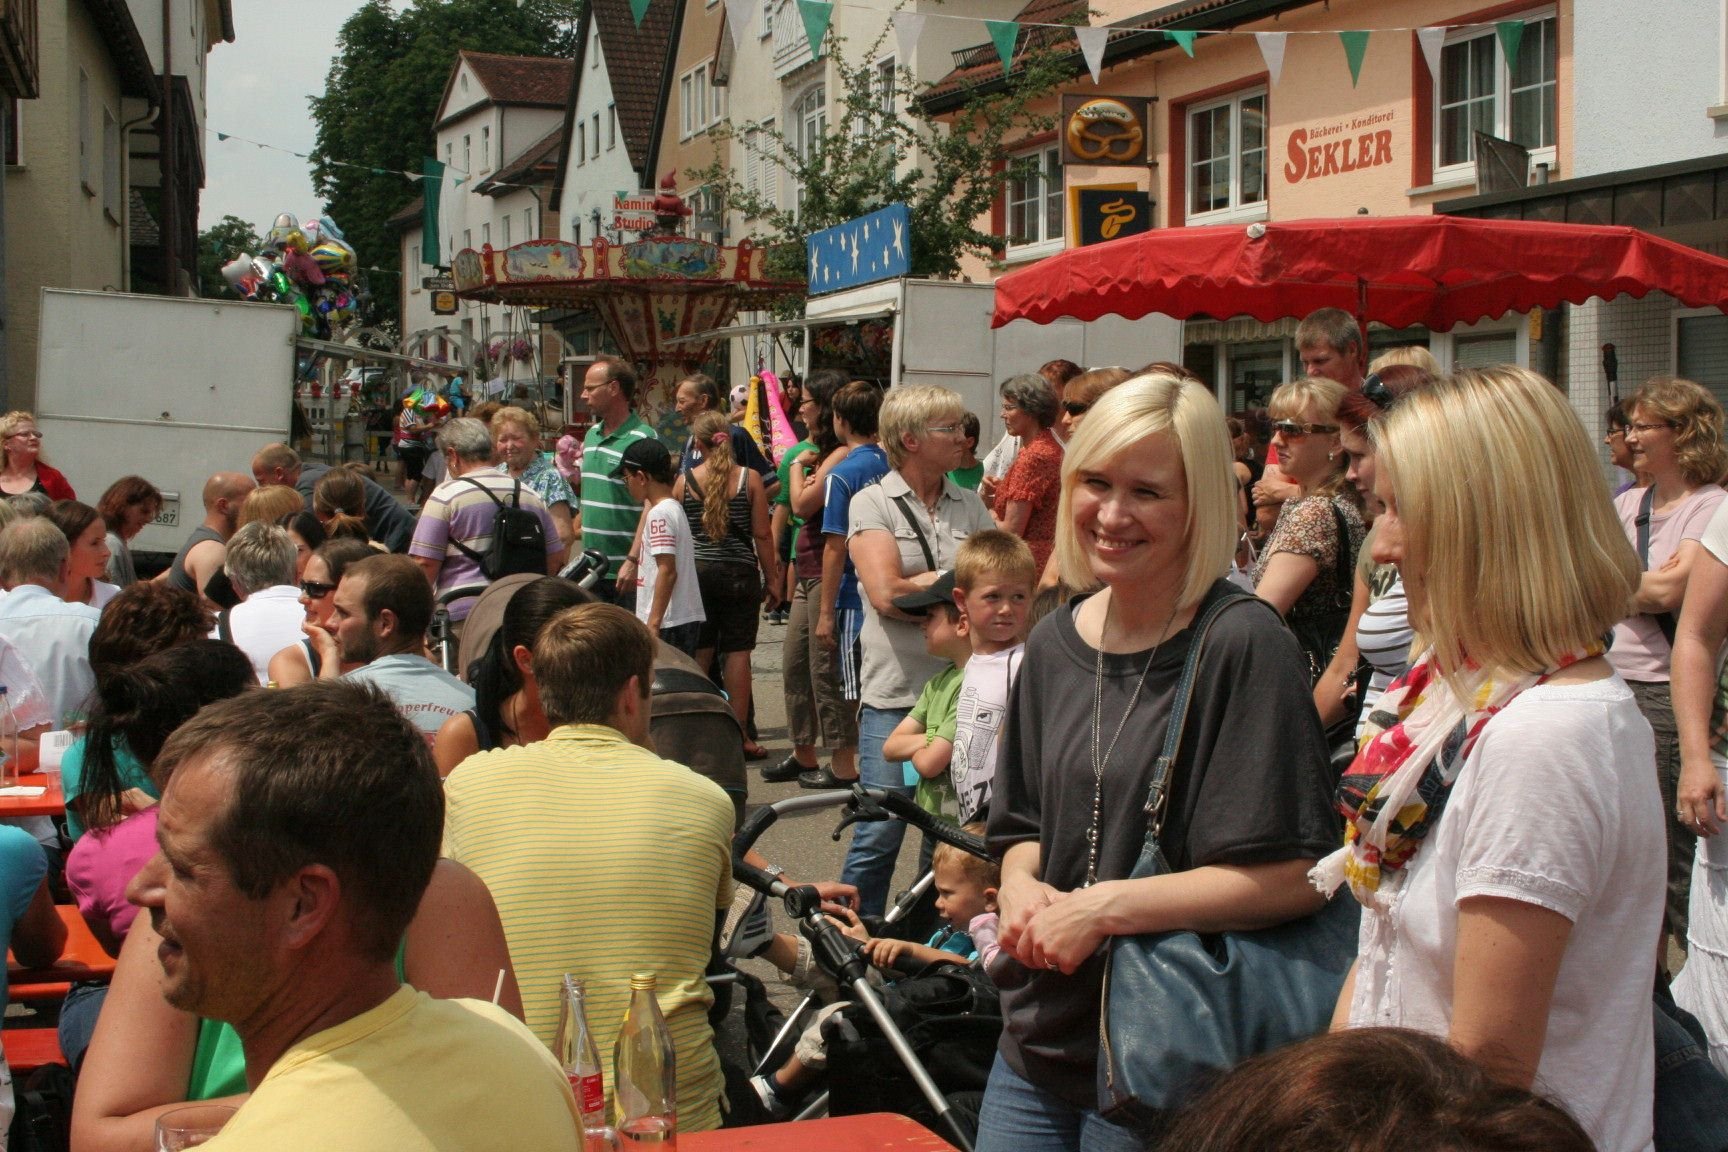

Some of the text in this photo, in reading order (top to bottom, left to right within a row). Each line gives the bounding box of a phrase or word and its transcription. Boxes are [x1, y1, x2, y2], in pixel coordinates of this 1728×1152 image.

[1309, 110, 1394, 140] Bäckerei Konditorei
[1284, 127, 1393, 184] SEKLER
[614, 196, 655, 210] Kamin
[614, 215, 654, 230] Studio
[650, 518, 667, 534] 62
